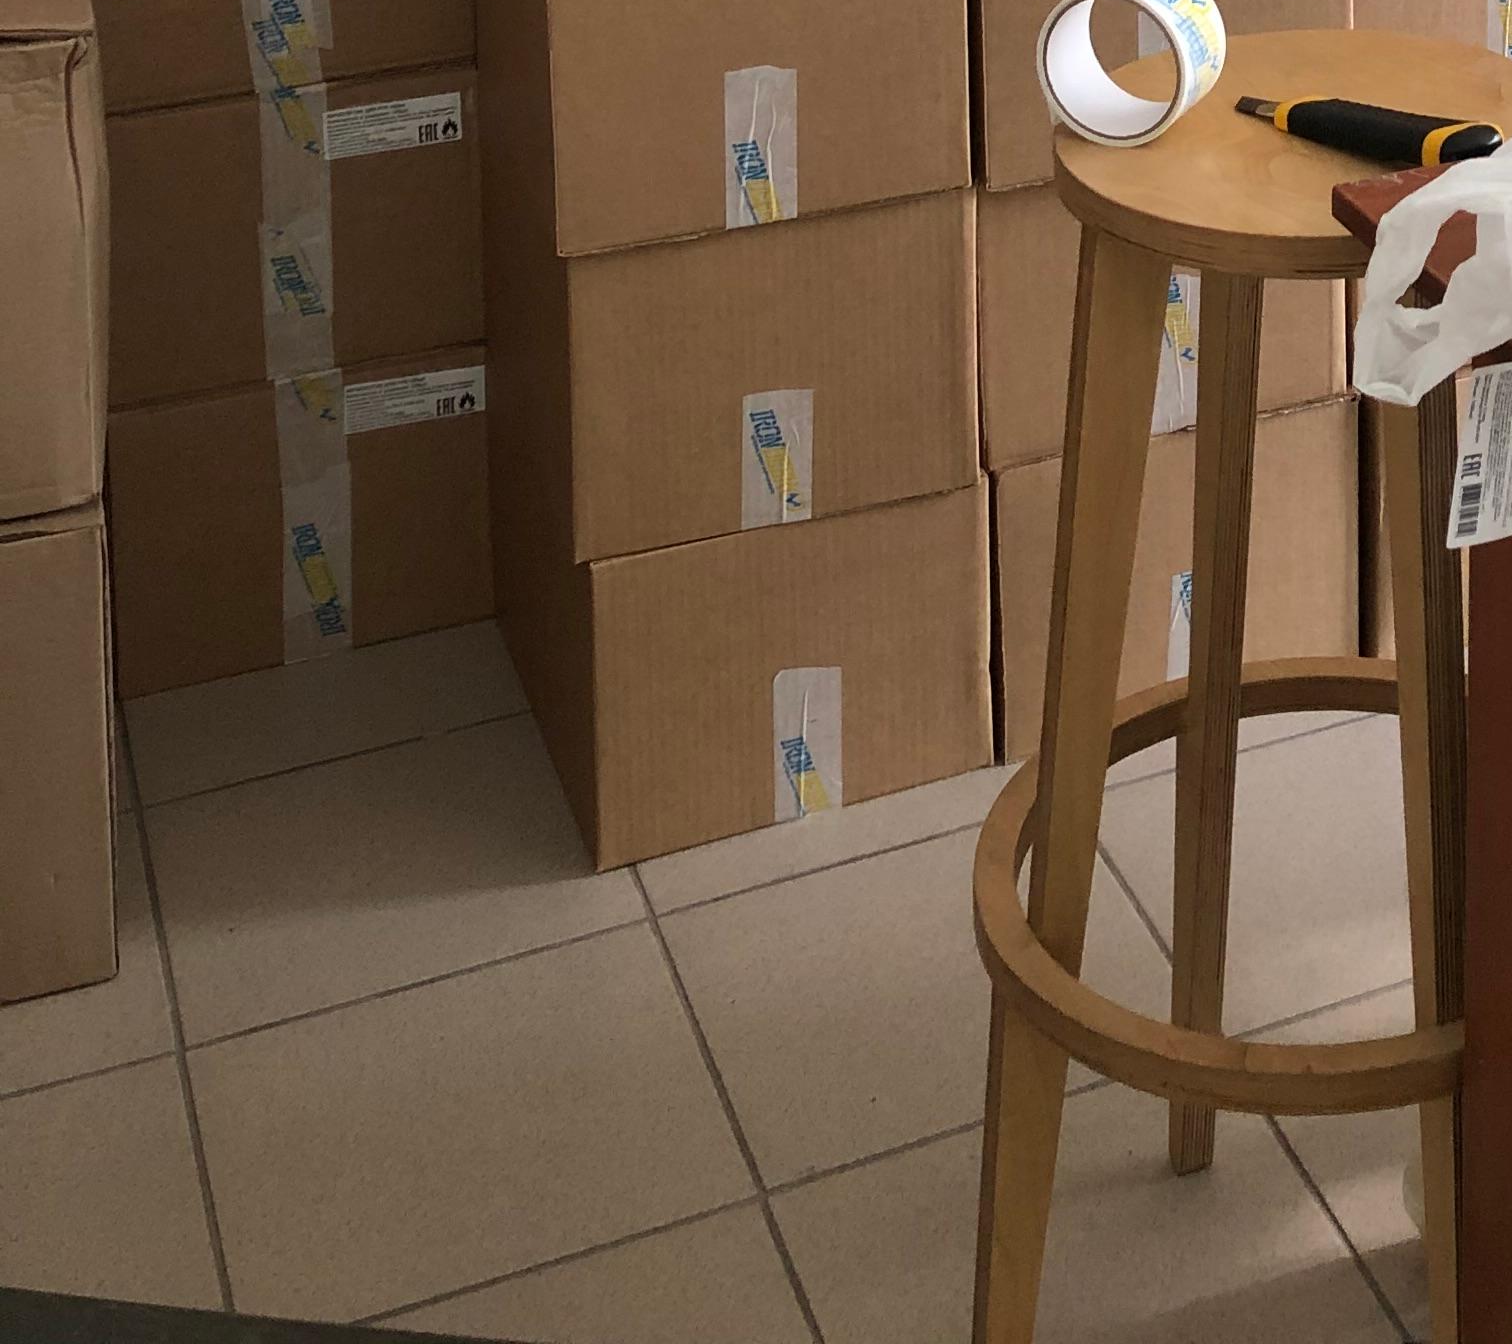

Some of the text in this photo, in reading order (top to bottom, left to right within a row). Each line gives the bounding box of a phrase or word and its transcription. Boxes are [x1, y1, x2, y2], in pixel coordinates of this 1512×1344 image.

[733, 141, 768, 180] IRON
[750, 411, 785, 449] IRON
[1461, 453, 1483, 480] EAC
[780, 737, 815, 774] IRON
